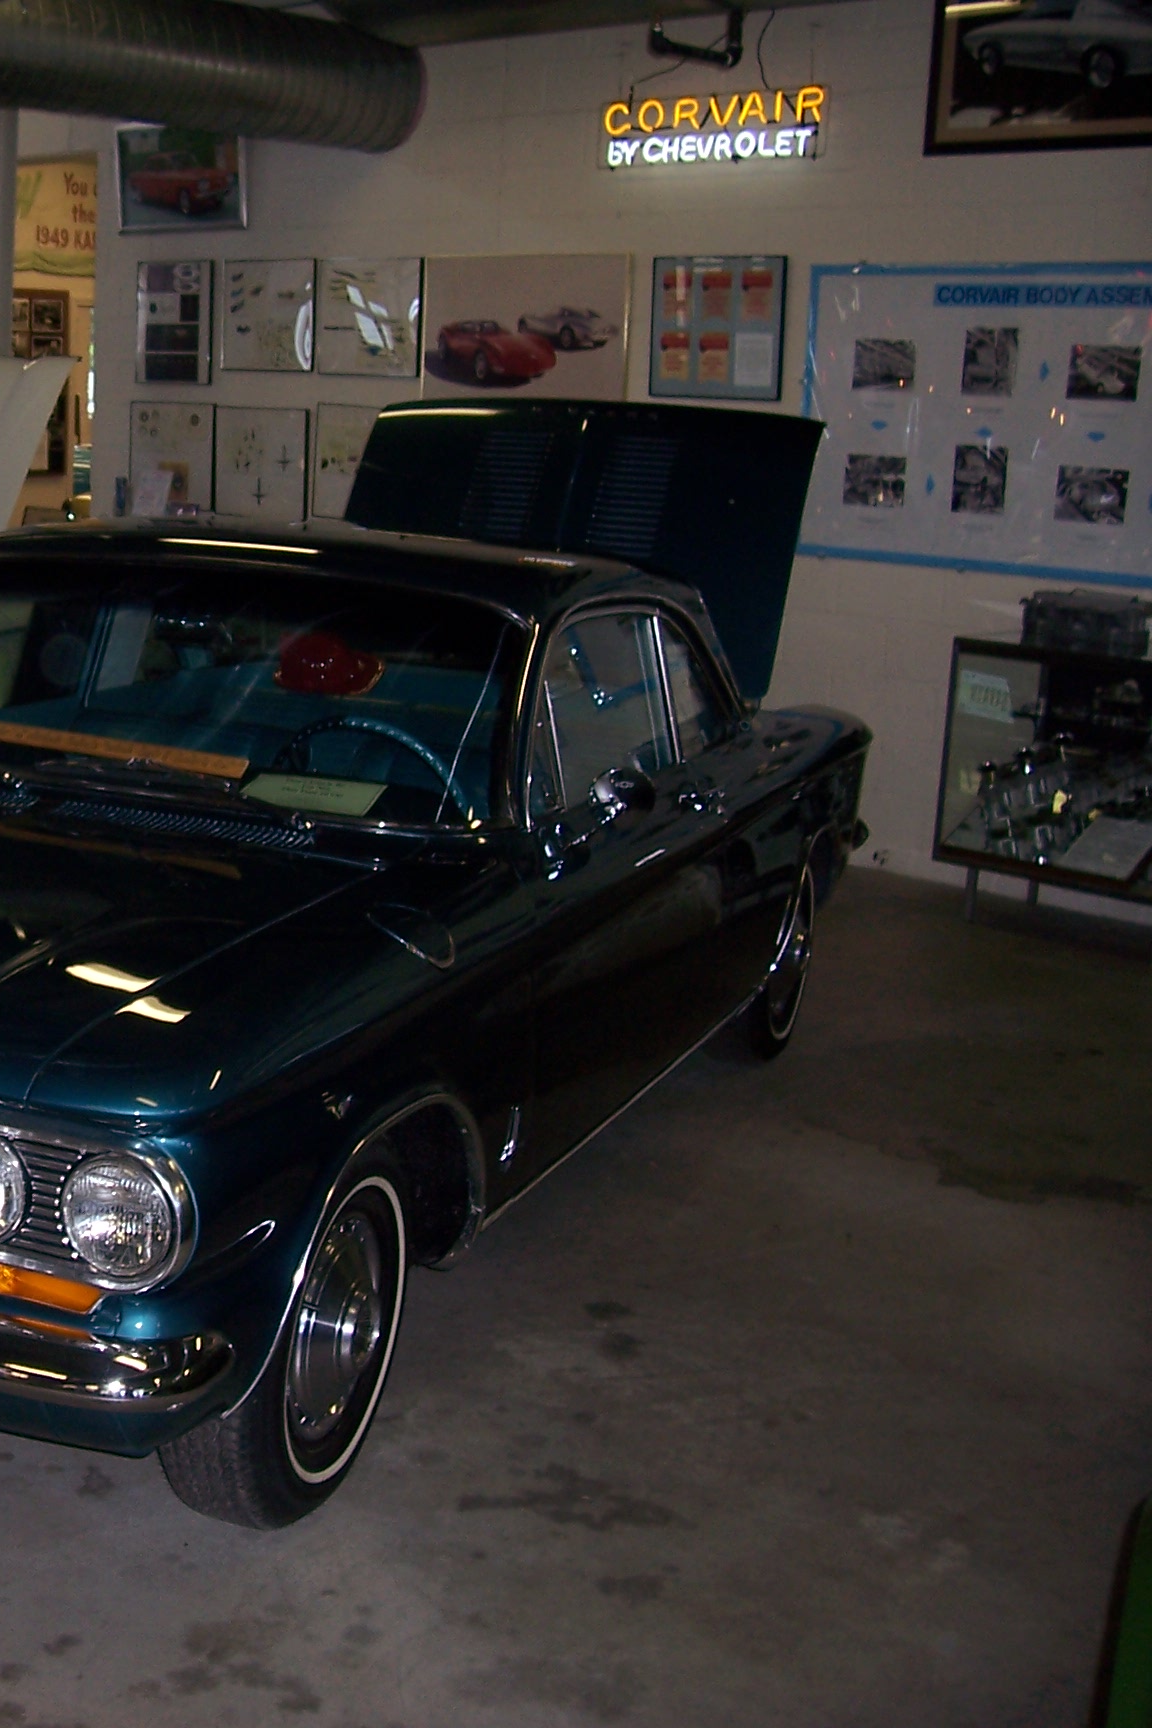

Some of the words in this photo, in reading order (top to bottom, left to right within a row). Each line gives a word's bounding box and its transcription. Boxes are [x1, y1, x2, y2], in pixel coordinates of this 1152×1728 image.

[604, 84, 825, 136] CORVAIR
[642, 128, 813, 164] CHEVROLET
[64, 171, 88, 197] You
[71, 203, 95, 224] the
[36, 224, 69, 248] 1949
[937, 285, 1020, 306] CORVAIR
[1025, 286, 1081, 306] BODY
